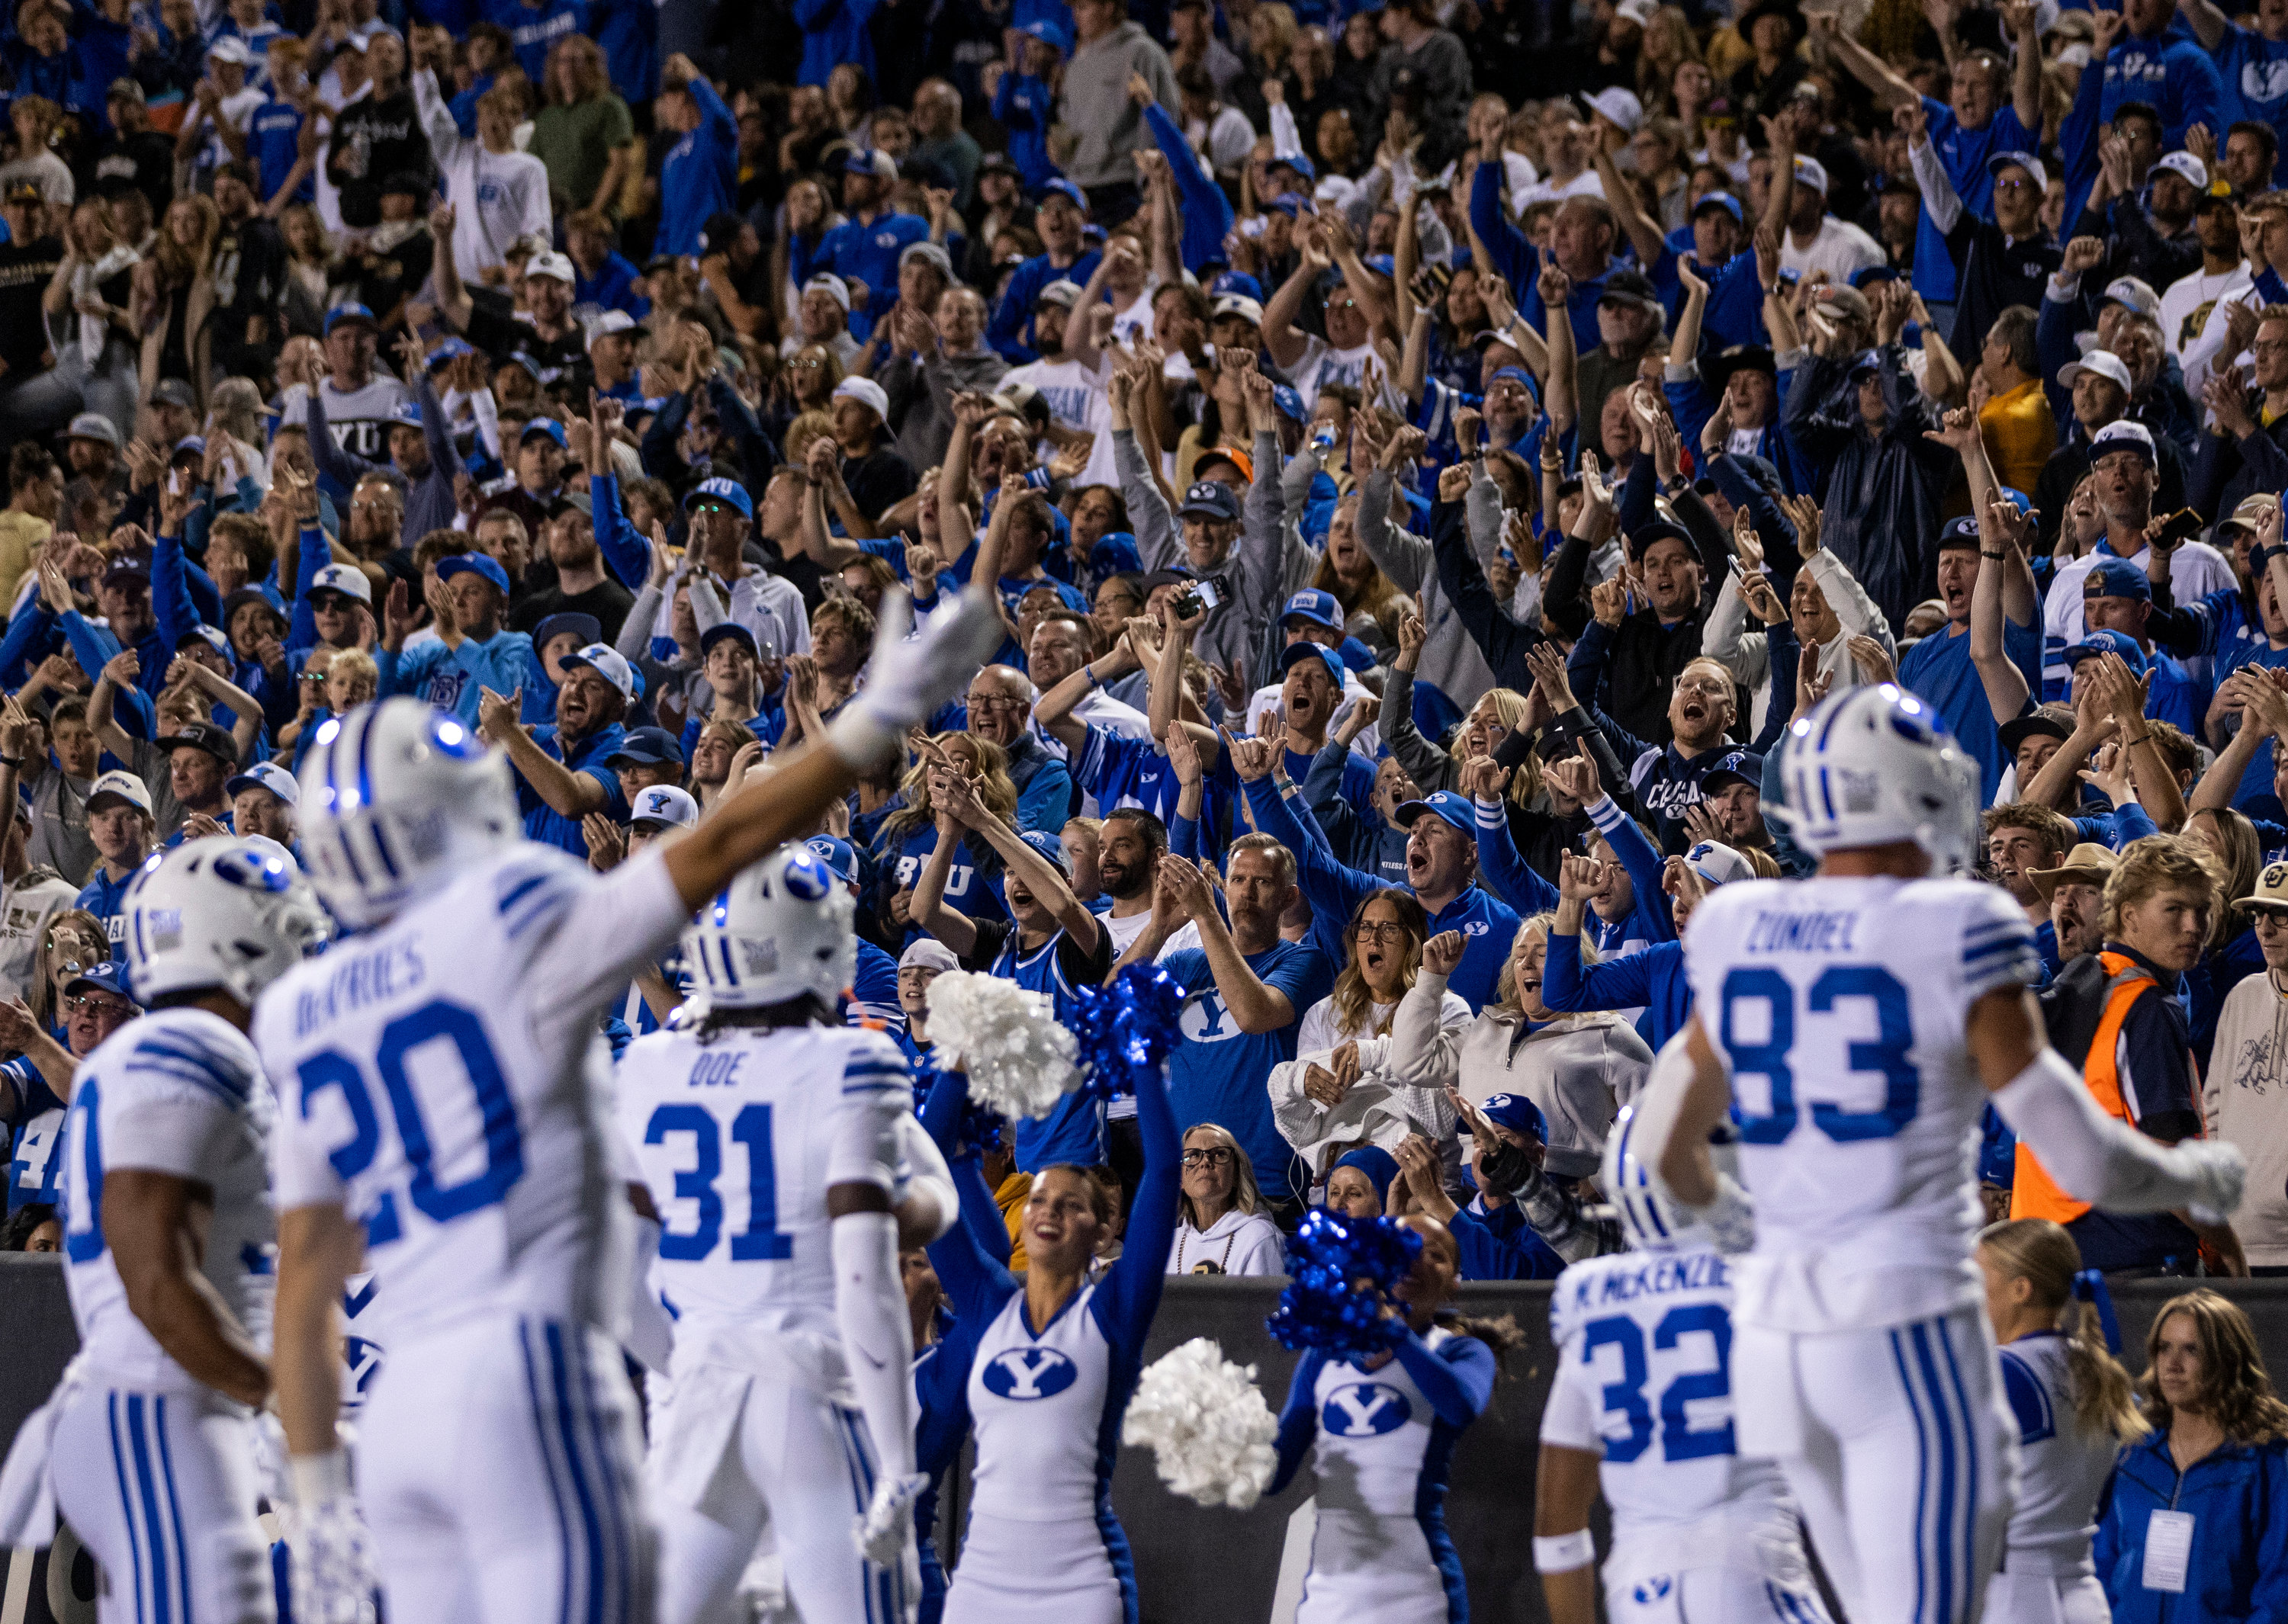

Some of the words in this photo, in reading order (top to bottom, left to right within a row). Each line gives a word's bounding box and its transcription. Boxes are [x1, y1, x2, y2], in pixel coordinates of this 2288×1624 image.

[329, 421, 381, 457] YU
[648, 794, 671, 814] Y
[688, 1051, 749, 1086] DOE
[1721, 965, 1918, 1144] 83
[14, 1108, 63, 1190] 4
[297, 999, 525, 1247] 20
[644, 1103, 794, 1261] 31
[995, 1349, 1065, 1397] Y
[1583, 1303, 1736, 1462] 32
[1331, 1385, 1399, 1435] Y
